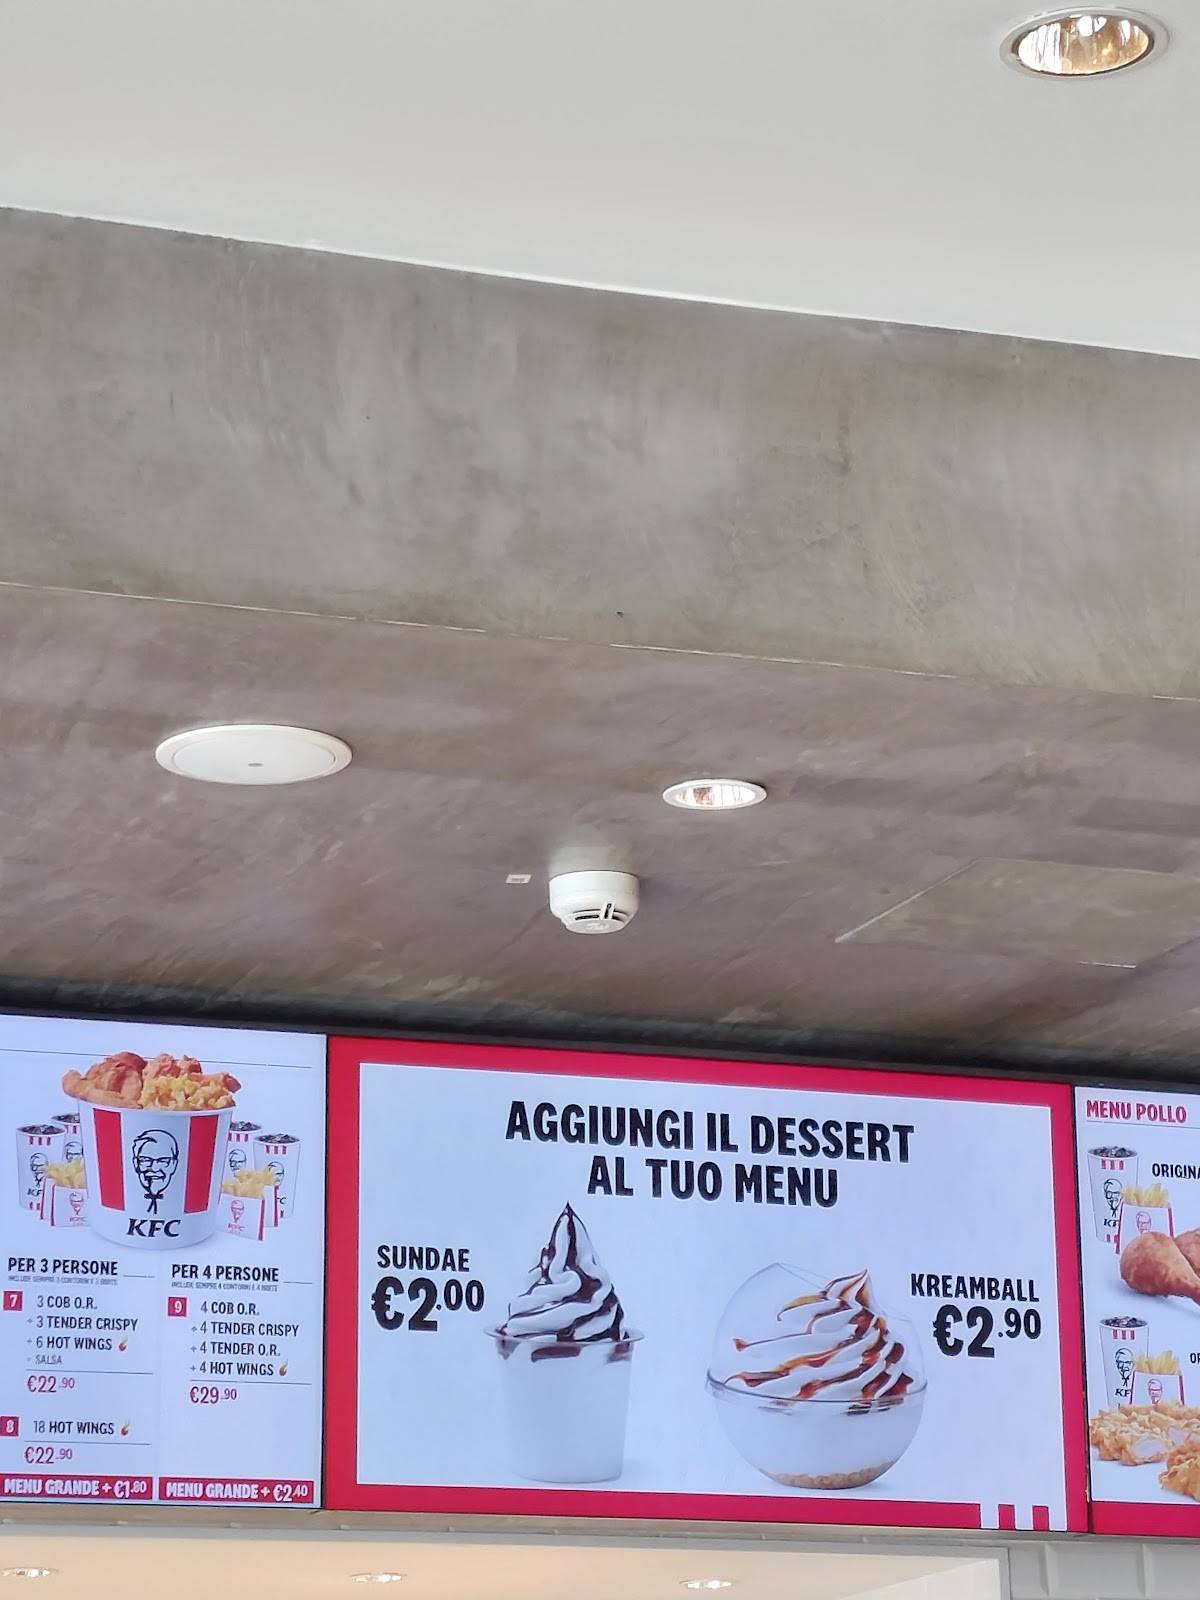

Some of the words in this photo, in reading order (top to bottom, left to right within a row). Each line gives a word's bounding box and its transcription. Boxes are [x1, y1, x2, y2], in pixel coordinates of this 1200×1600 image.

[1087, 1100, 1131, 1119] MENU
[1137, 1103, 1187, 1123] POLLO
[505, 1101, 694, 1149] AGGIUNGI
[707, 1112, 739, 1152] IL
[751, 1115, 914, 1163] DESSERT
[587, 1156, 634, 1196] AL
[645, 1159, 722, 1201] TUO
[735, 1164, 839, 1208] MENU
[127, 1218, 181, 1237] KFC
[377, 1245, 470, 1272] SUNDAE
[8, 1258, 35, 1272] PER
[40, 1259, 49, 1273] 3
[53, 1260, 118, 1276] PERSONE
[172, 1264, 199, 1279] PER
[202, 1265, 212, 1279] 4
[216, 1266, 279, 1282] PERSONE
[910, 1273, 1040, 1303] KREAMBALL
[9, 1295, 18, 1307] 7
[37, 1295, 44, 1307] 3
[47, 1296, 71, 1309] COB
[74, 1297, 98, 1310] O.R.
[173, 1301, 182, 1313] 9
[201, 1301, 208, 1313] 4
[211, 1302, 234, 1314] COB
[237, 1303, 259, 1316] O.R.
[370, 1276, 485, 1332] €2.00
[36, 1316, 44, 1328] 3
[47, 1316, 92, 1329] TENDER
[96, 1318, 138, 1331] CRISPY
[200, 1322, 208, 1334] 4
[211, 1322, 254, 1335] TENDER
[259, 1324, 299, 1337] CRISPY
[933, 1304, 1041, 1358] €2.90
[36, 1336, 43, 1348] 6
[47, 1337, 71, 1349] HOT
[74, 1337, 112, 1350] WINGS
[200, 1342, 208, 1354] 4
[210, 1343, 254, 1355] TENDER
[258, 1344, 280, 1356] O.R.
[35, 1355, 62, 1365] SALSA
[199, 1362, 207, 1374] 4
[210, 1362, 233, 1375] HOT
[236, 1363, 274, 1376] WINGS
[27, 1375, 75, 1393] €22.90
[190, 1387, 237, 1404] €29.90
[6, 1421, 14, 1432] 8
[33, 1421, 45, 1433] 18
[49, 1421, 73, 1434] HOT
[76, 1422, 114, 1435] WINGS
[24, 1447, 73, 1464] €22.90
[4, 1479, 42, 1493] MENU
[45, 1480, 99, 1495] GRANDE
[166, 1482, 203, 1497] MENU
[206, 1484, 258, 1498] GRANDE
